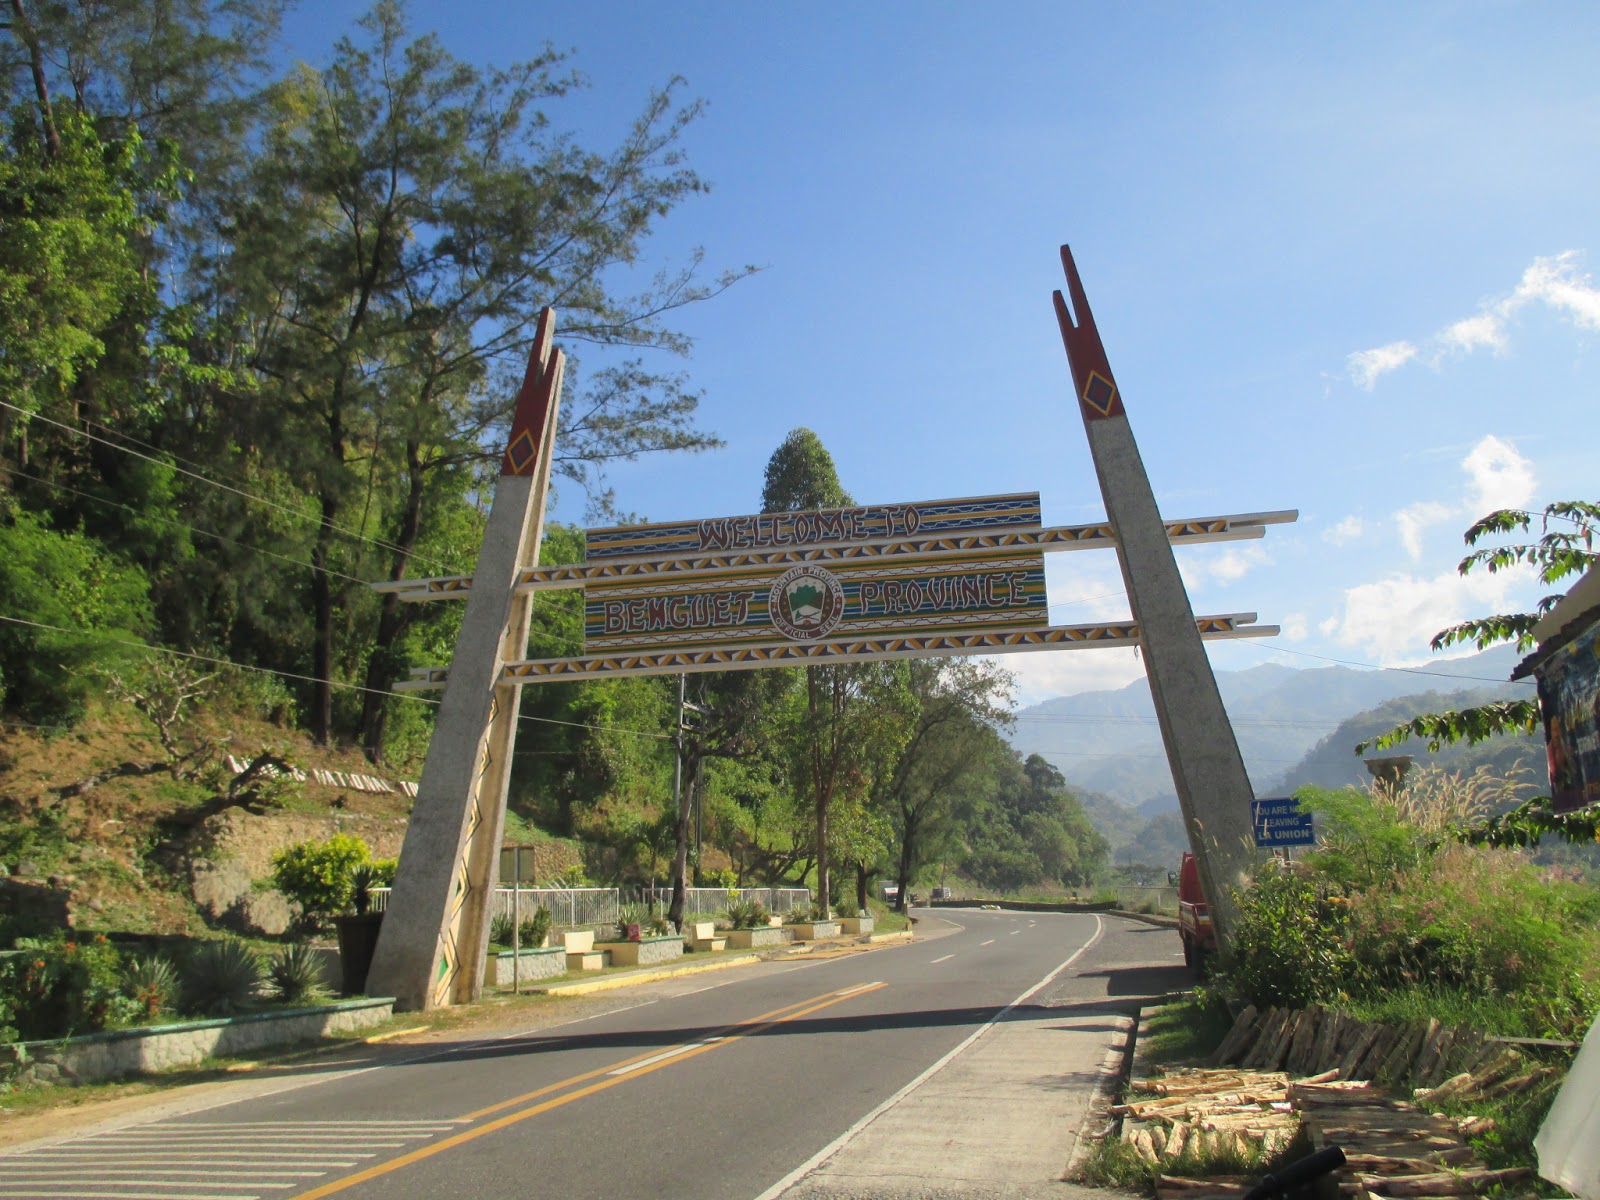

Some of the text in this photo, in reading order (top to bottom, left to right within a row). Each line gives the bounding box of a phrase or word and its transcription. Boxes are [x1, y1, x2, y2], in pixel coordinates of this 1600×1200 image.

[698, 505, 920, 551] WELCOME TO
[772, 567, 842, 603] MOUNTAIN PROVINCE
[604, 572, 1029, 634] BENGUET PROVINCE
[775, 614, 839, 639] OFFICIAL SEAL
[1265, 817, 1299, 828] EAVING
[1271, 805, 1288, 815] ARE
[1274, 829, 1309, 840] UNION
